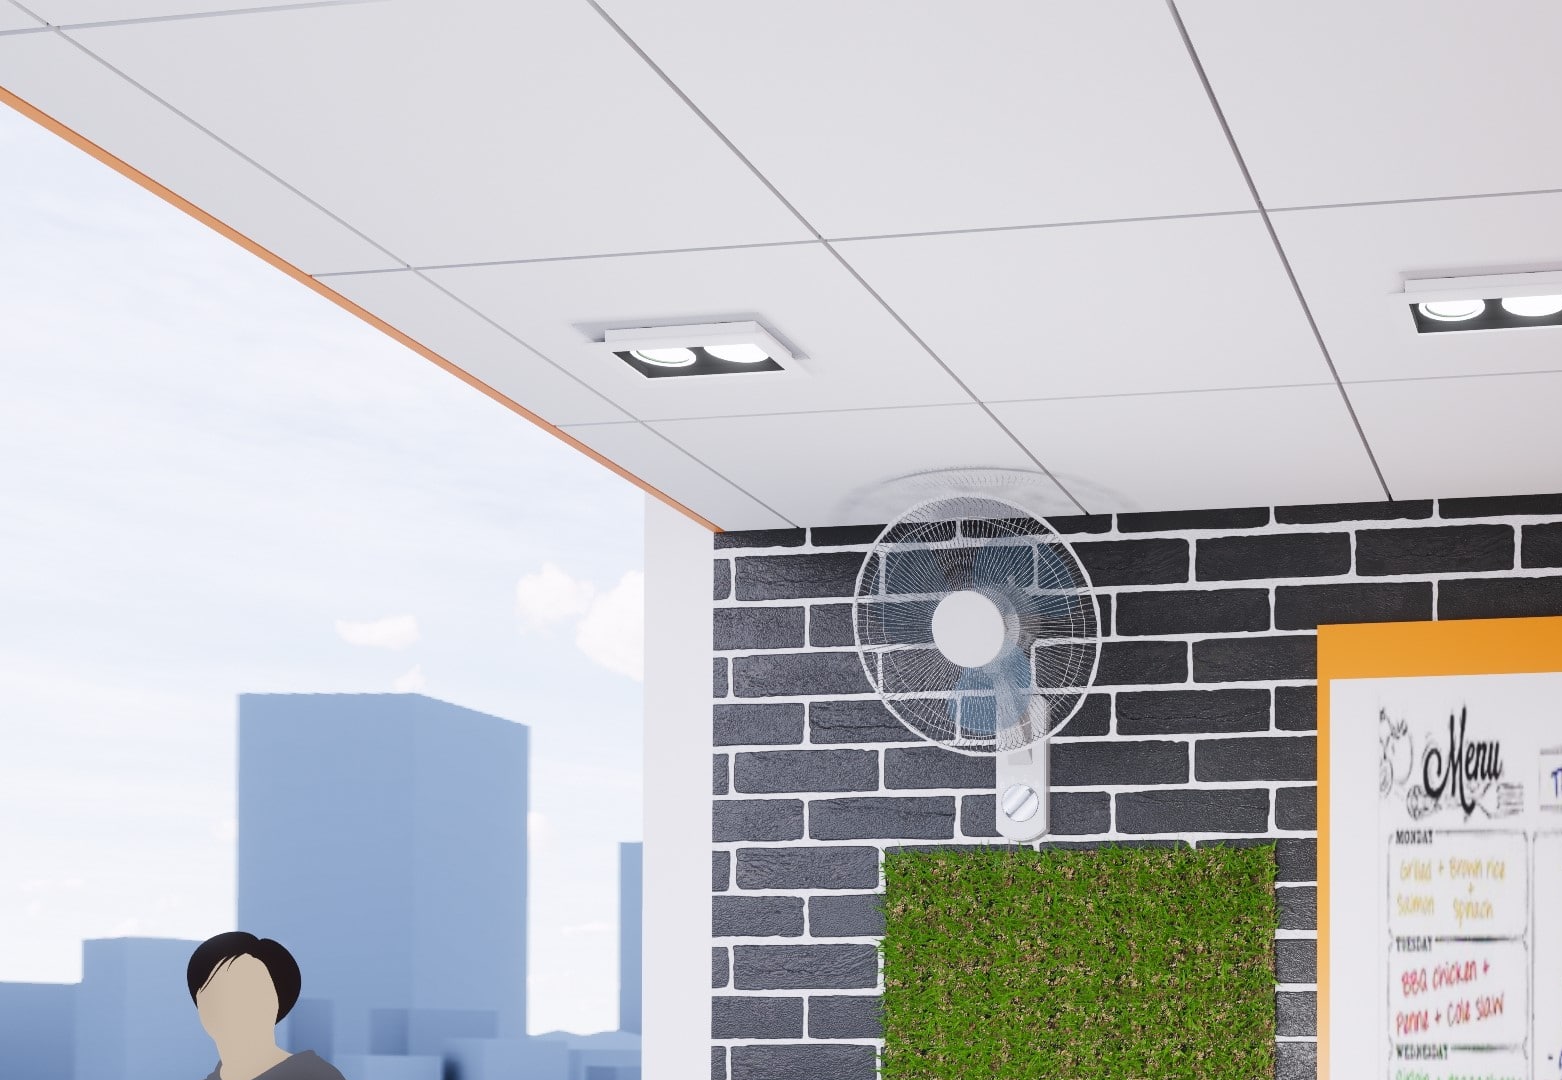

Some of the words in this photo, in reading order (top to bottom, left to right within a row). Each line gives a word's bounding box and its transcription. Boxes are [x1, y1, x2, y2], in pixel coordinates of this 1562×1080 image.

[1423, 705, 1502, 815] Menu
[1395, 830, 1433, 844] MONDAY
[1395, 935, 1433, 952] TUESDAY
[1432, 960, 1477, 990] chicken
[1395, 1044, 1448, 1060] WEDNESDAY
